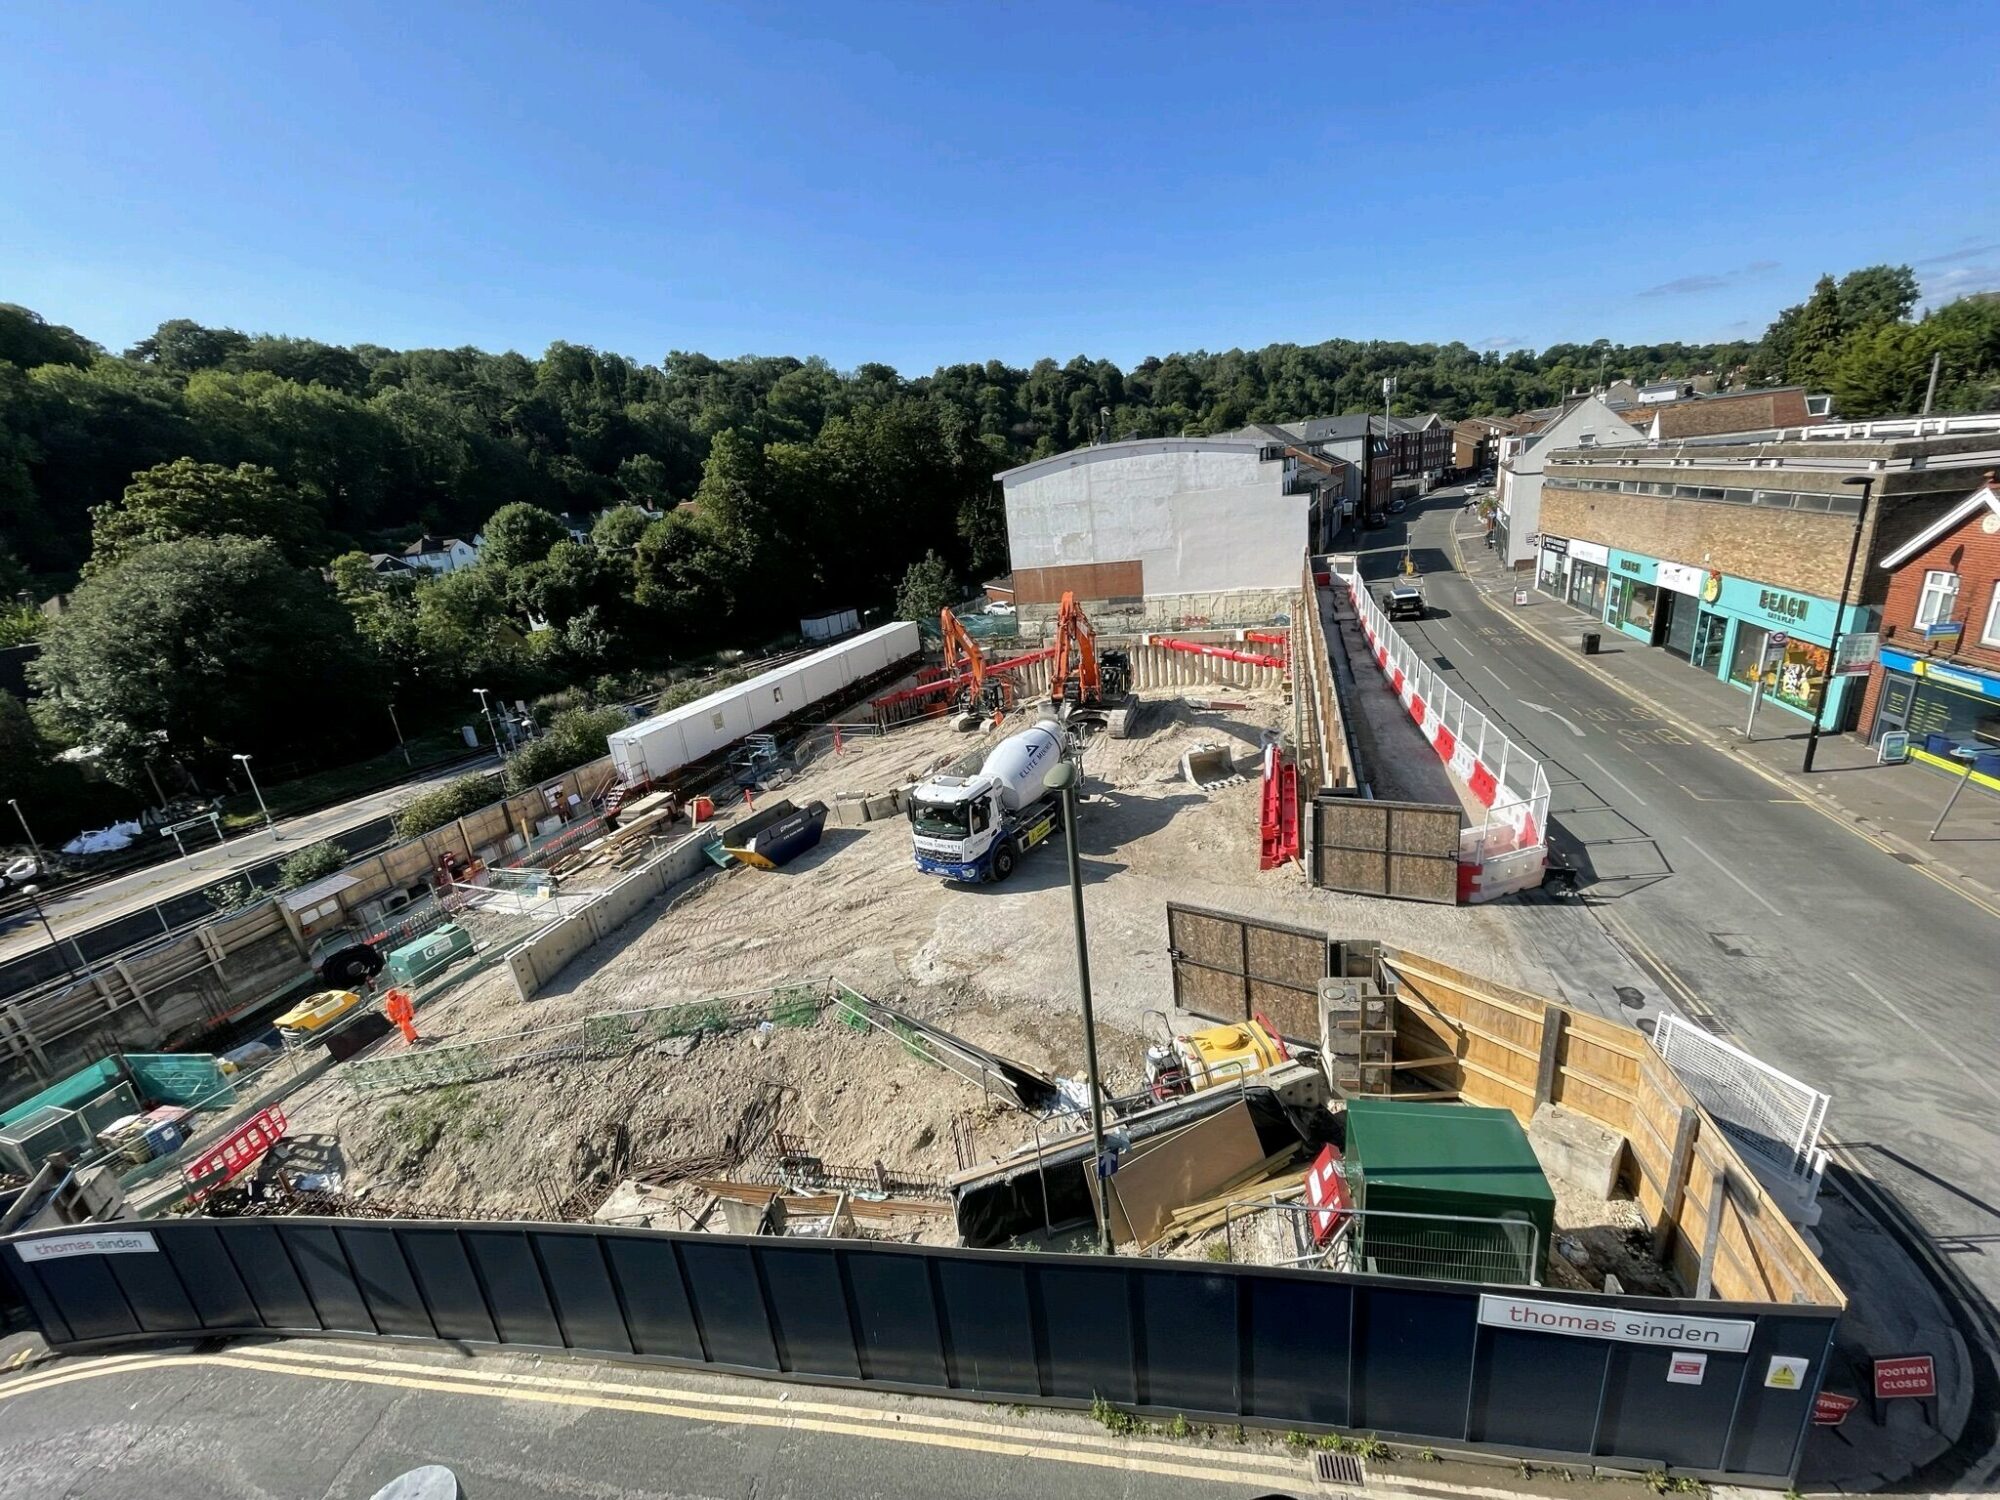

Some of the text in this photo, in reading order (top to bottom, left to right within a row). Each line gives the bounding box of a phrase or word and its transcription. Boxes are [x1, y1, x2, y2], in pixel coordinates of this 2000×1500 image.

[1759, 590, 1809, 621] BEACH
[1617, 728, 1692, 745] BUS
[1019, 759, 1038, 778] ELITE
[35, 1238, 143, 1255] thomas sinden
[1509, 1305, 1720, 1343] thomas sinden
[1878, 1365, 1929, 1377] FOOTWAY
[1882, 1379, 1928, 1390] CLOSED
